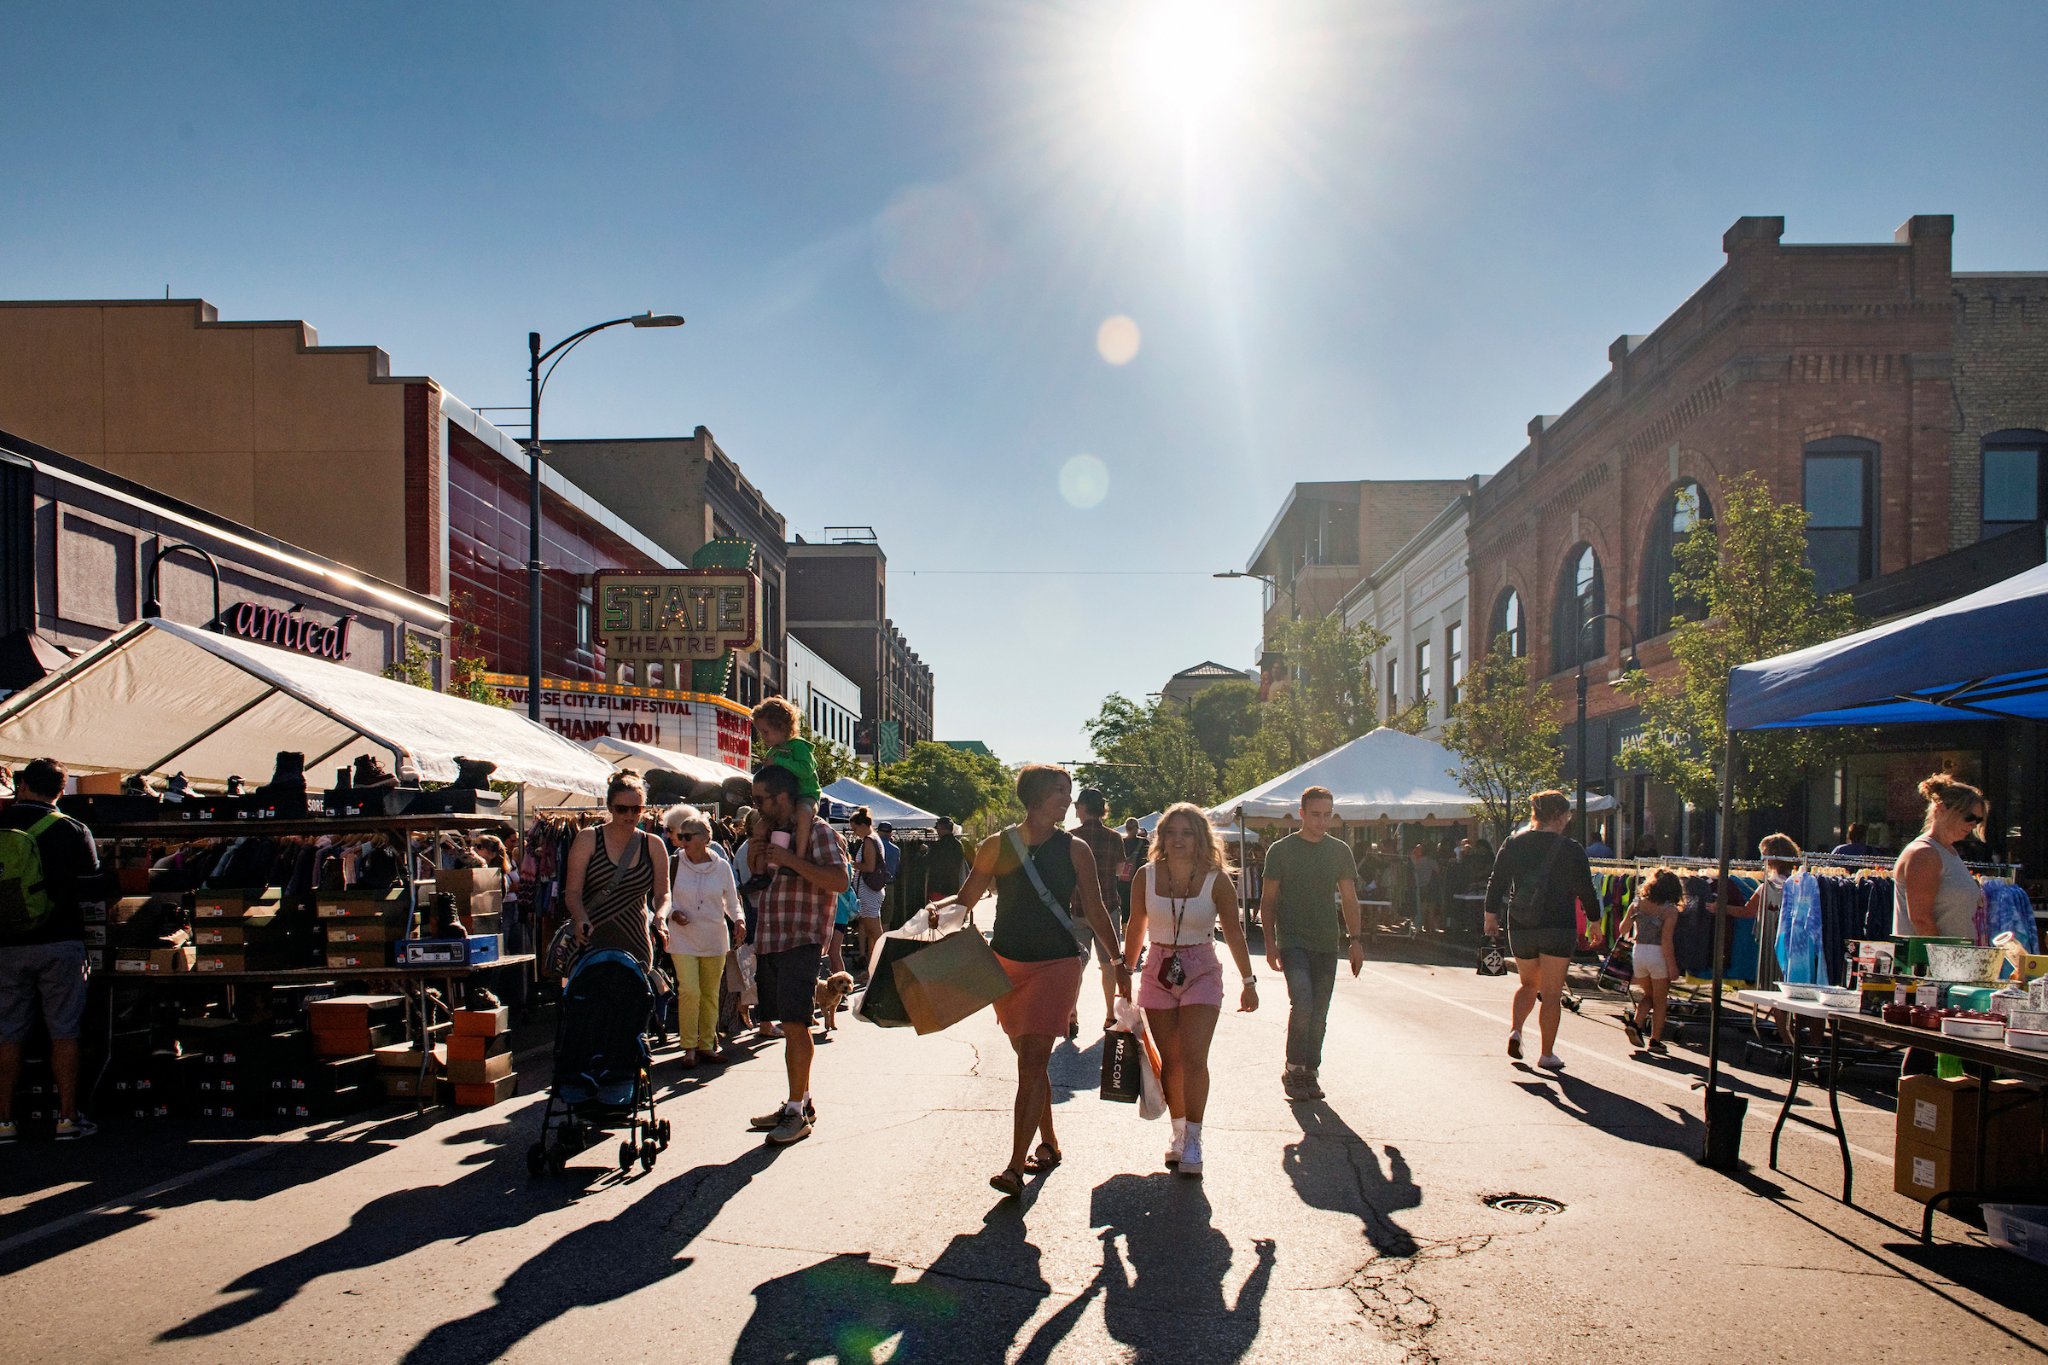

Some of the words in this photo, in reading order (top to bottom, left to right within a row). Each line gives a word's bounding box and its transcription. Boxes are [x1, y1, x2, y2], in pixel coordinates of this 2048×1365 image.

[604, 585, 745, 631] STATE
[236, 601, 357, 661] amical
[614, 636, 716, 653] THEATRE
[563, 692, 595, 707] CITY
[545, 717, 611, 741] THANK
[617, 721, 660, 745] YOU!
[307, 799, 325, 812] SORE
[1487, 956, 1501, 967] 22
[1112, 1039, 1125, 1089] M22.COM
